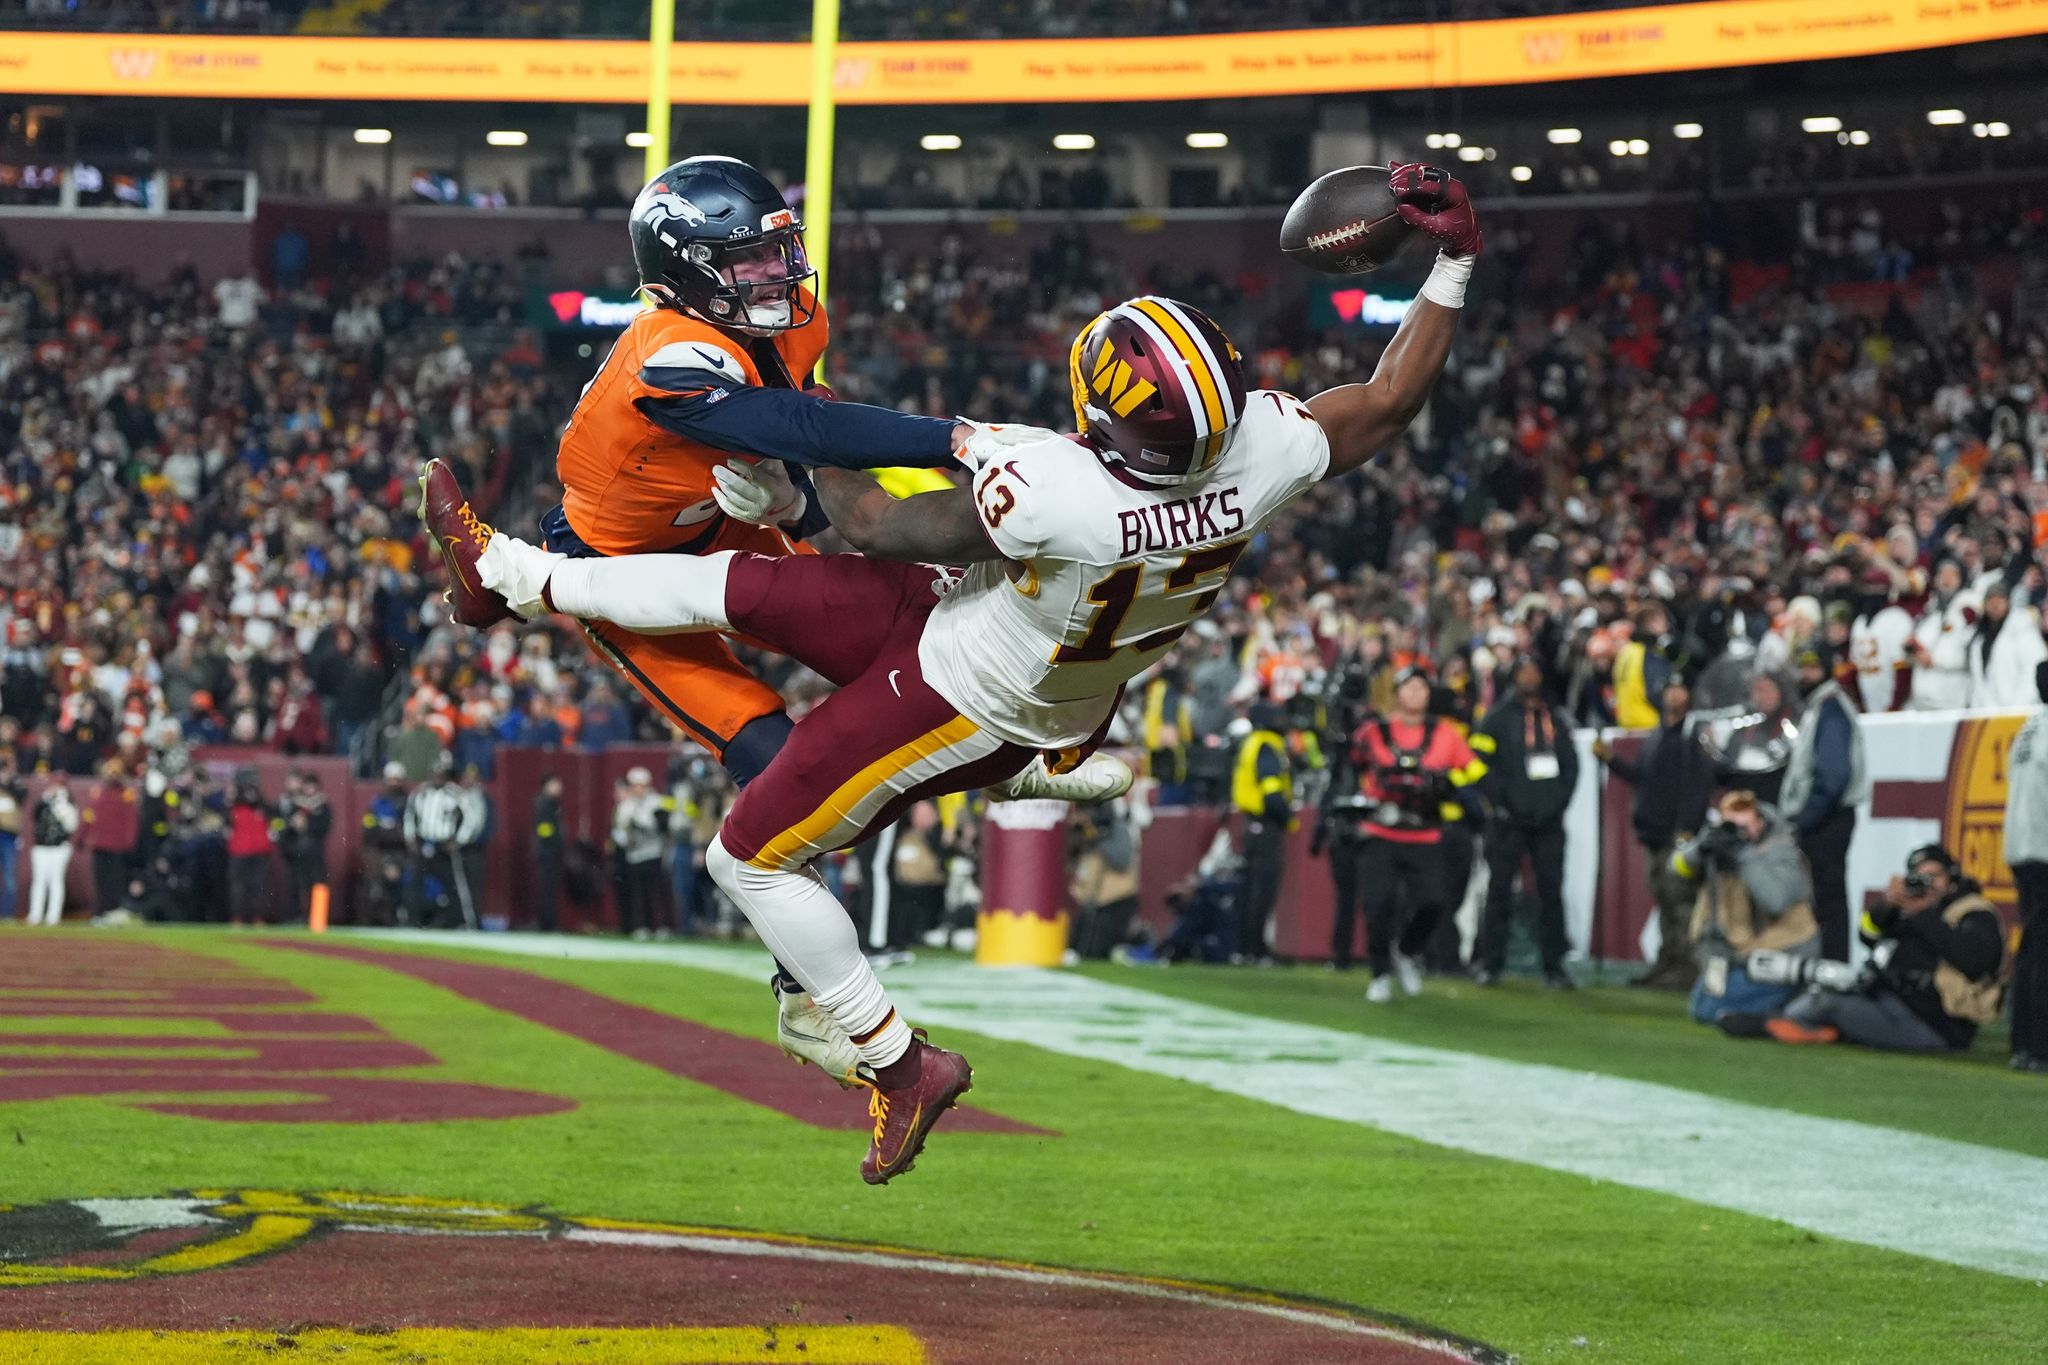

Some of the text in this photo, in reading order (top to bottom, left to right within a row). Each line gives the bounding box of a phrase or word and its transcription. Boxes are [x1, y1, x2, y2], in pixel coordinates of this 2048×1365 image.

[1092, 336, 1157, 418] W
[977, 467, 1014, 527] 13
[1118, 486, 1244, 558] BURKS
